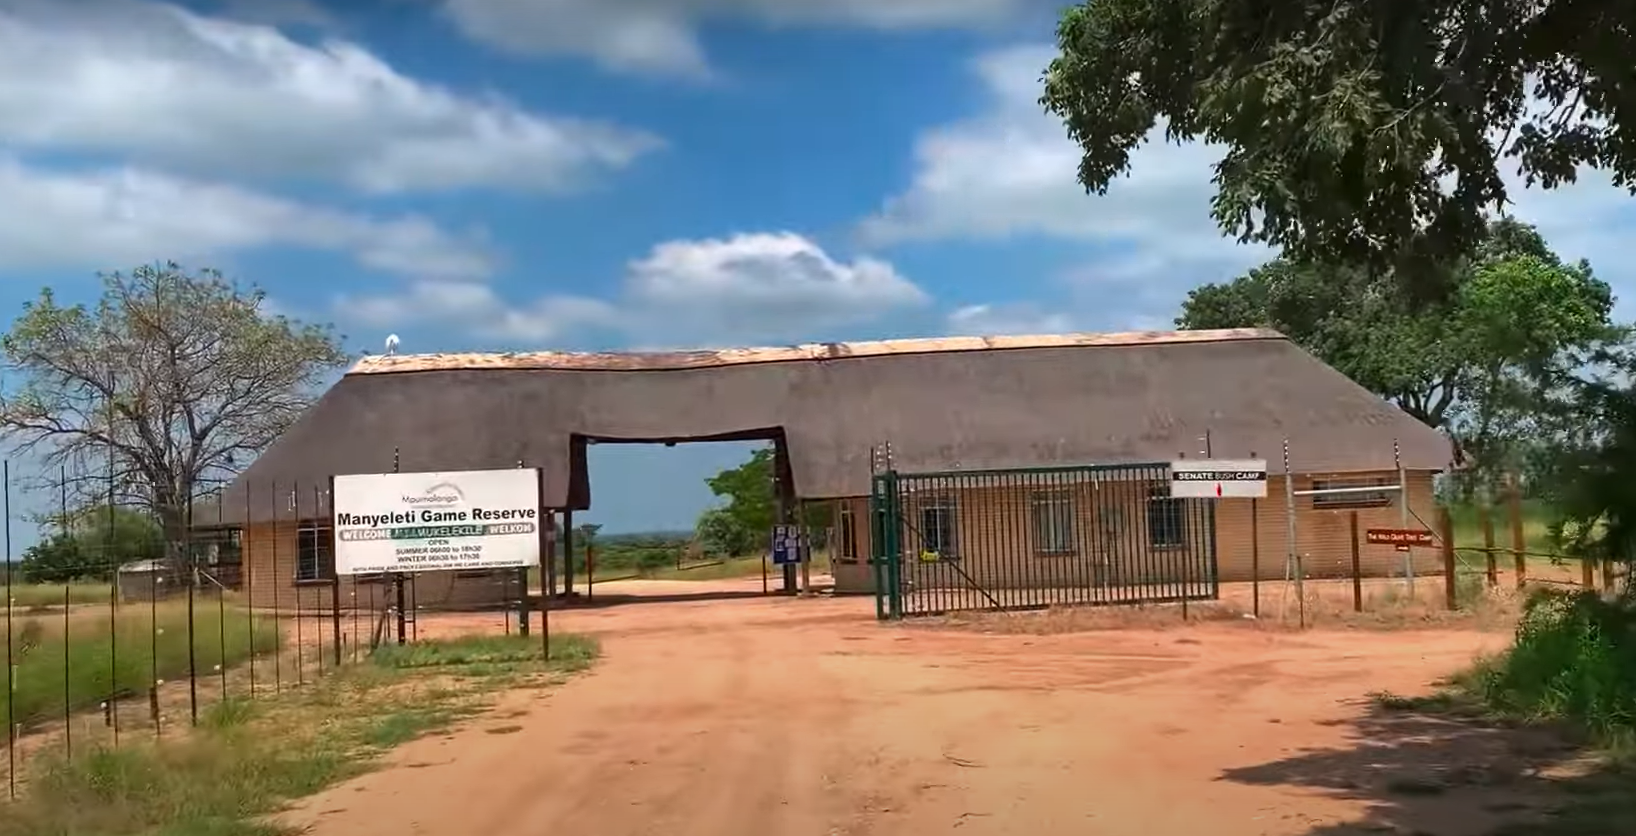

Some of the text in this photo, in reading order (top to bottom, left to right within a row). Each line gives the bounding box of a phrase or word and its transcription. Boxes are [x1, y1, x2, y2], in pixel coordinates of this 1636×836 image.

[1178, 472, 1260, 480] SENATE BUSH CAMP
[338, 508, 536, 528] Manyeleti Game Reserve
[342, 528, 391, 540] WELCOME
[396, 547, 428, 555] SUMMER
